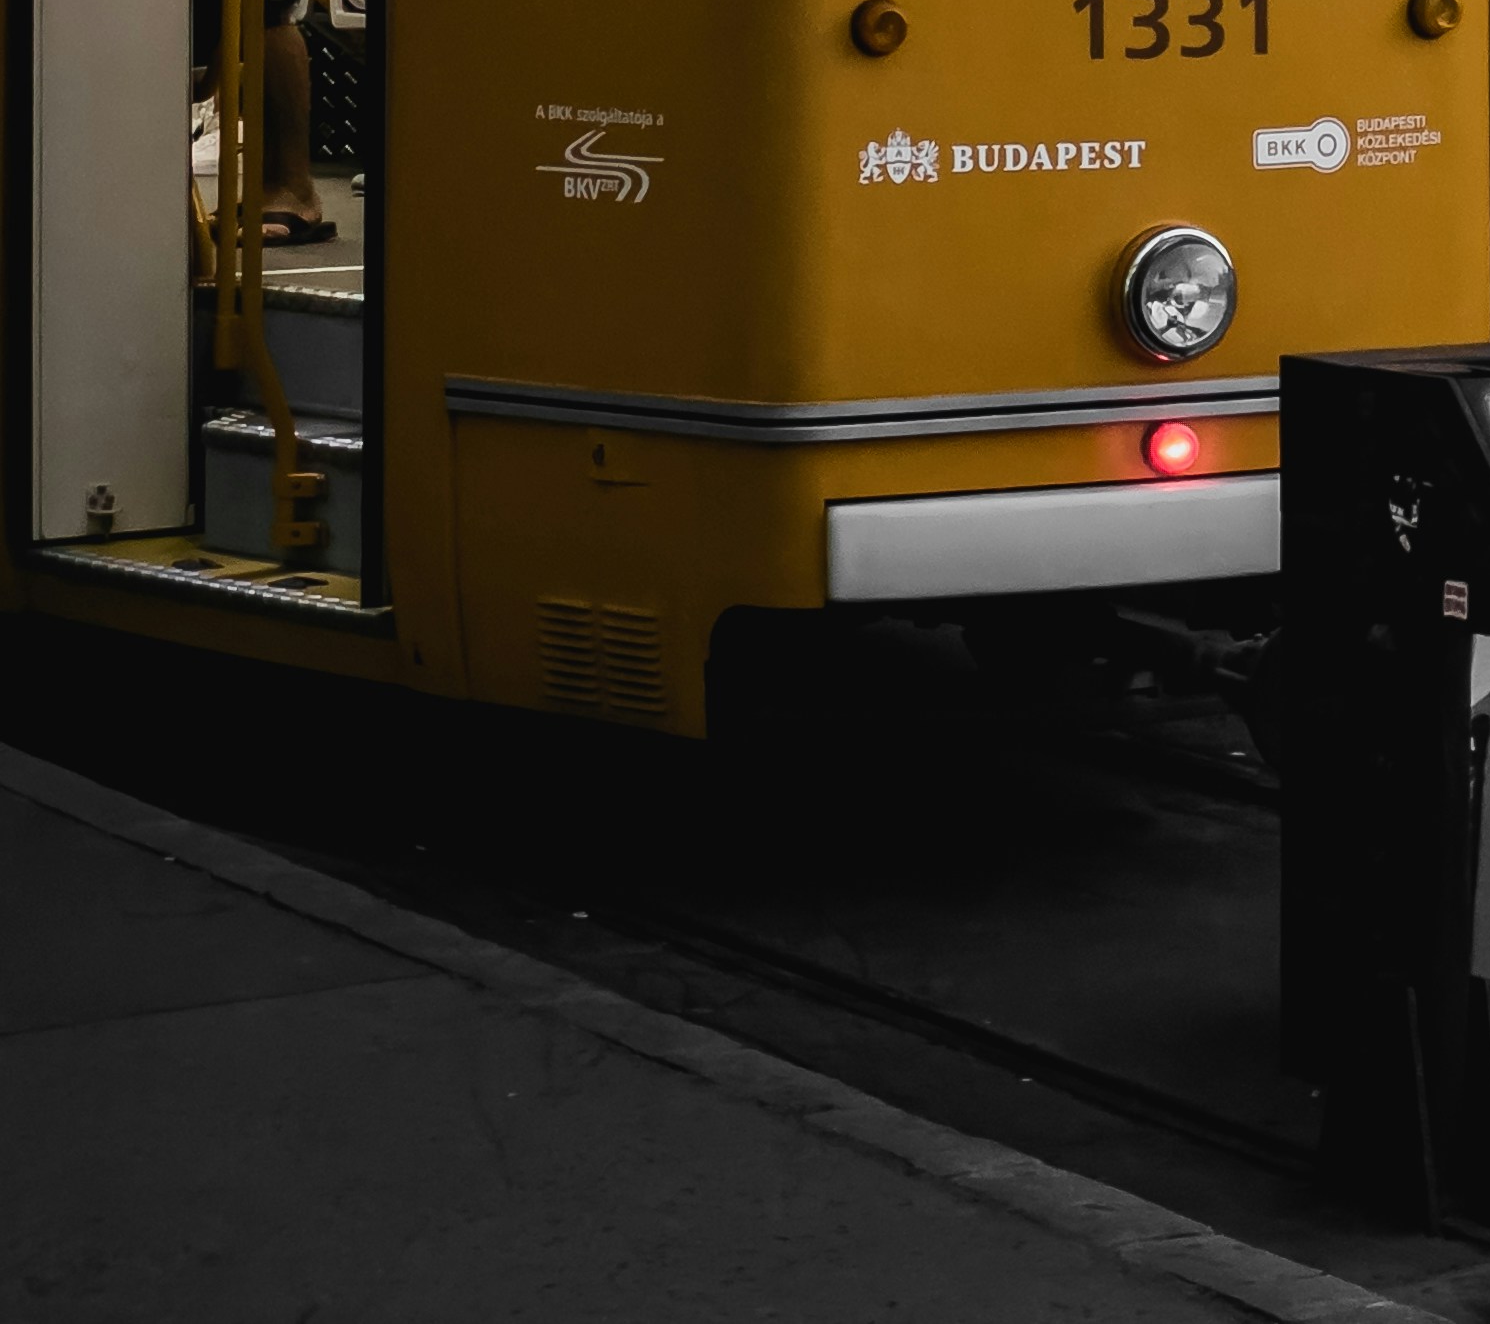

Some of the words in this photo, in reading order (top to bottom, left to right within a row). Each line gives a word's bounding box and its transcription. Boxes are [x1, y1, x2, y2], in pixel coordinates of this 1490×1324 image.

[535, 104, 545, 119] A
[548, 104, 573, 120] BKK
[656, 113, 664, 126] a
[1356, 115, 1426, 132] BUDAPESTI
[1267, 139, 1306, 156] BKK
[1356, 130, 1441, 149] KÖZLEKEDÉSI
[951, 140, 1146, 173] BUDAPEST
[1357, 149, 1417, 167] KÖZPONT
[564, 177, 600, 200] BKV
